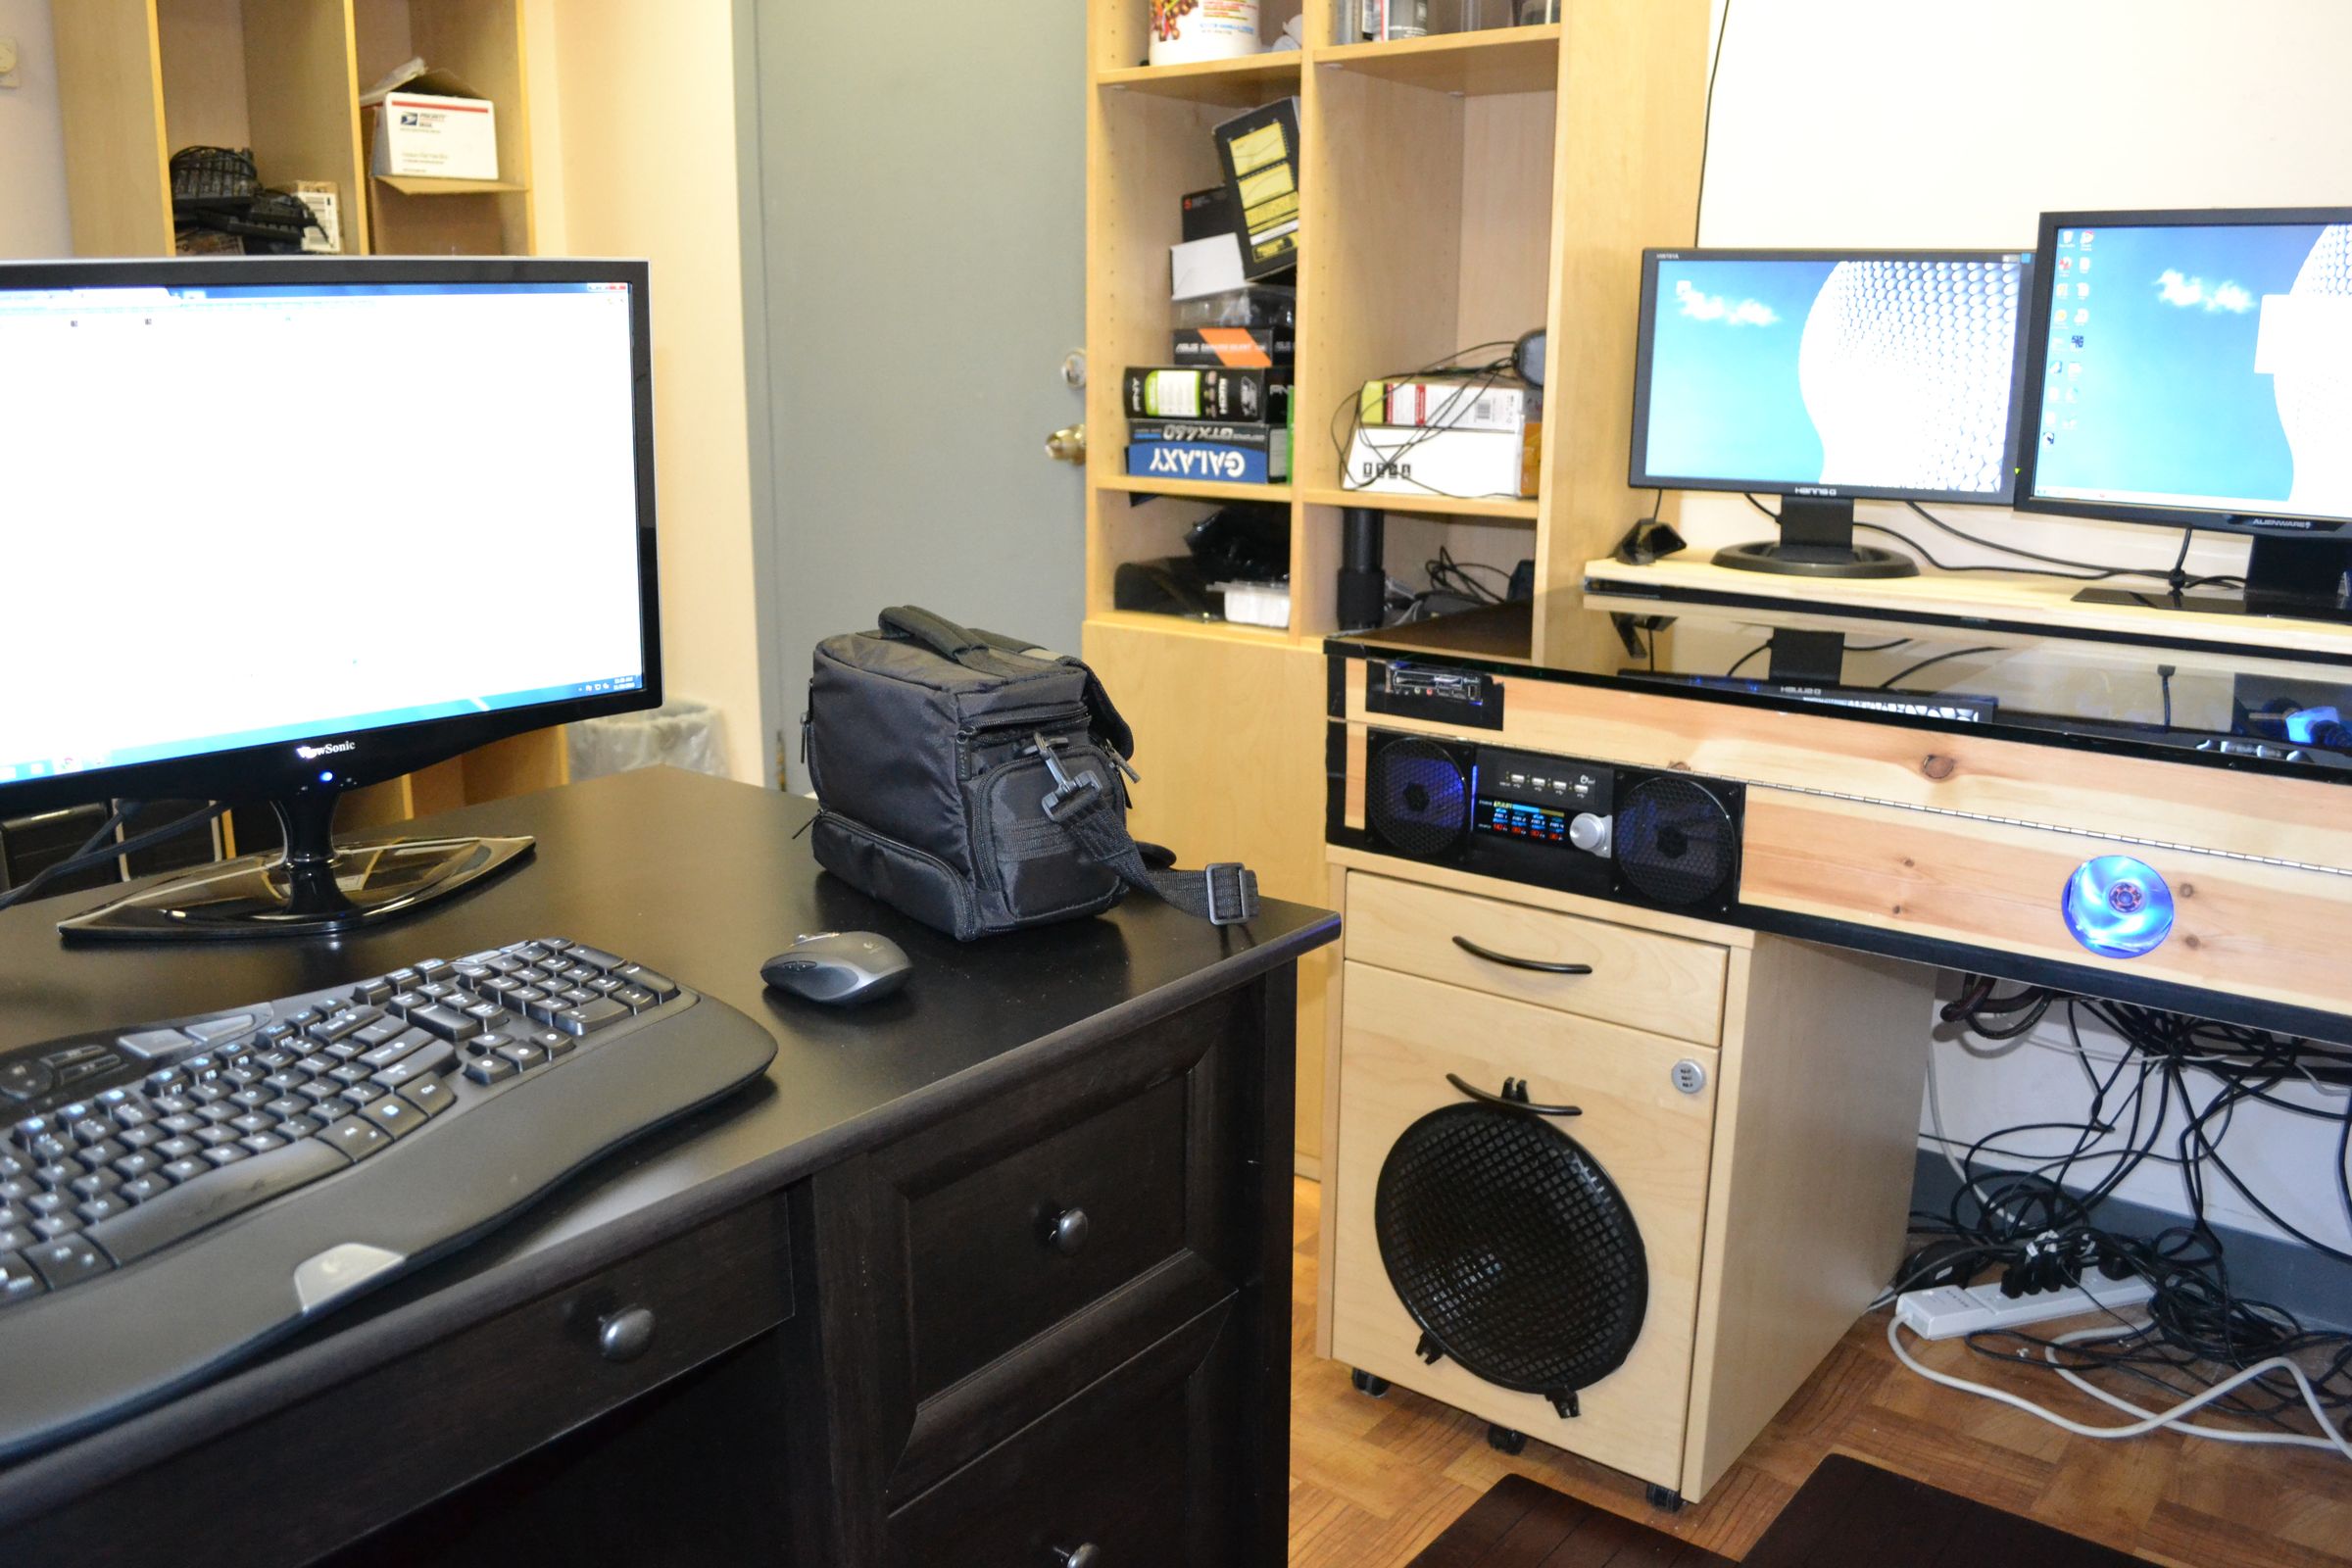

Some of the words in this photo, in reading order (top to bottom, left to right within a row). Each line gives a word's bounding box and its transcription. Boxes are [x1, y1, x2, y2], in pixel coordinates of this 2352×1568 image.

[1150, 448, 1246, 478] GALAXY
[2252, 517, 2305, 528] ALIENWARE
[296, 740, 356, 760] VwSonic
